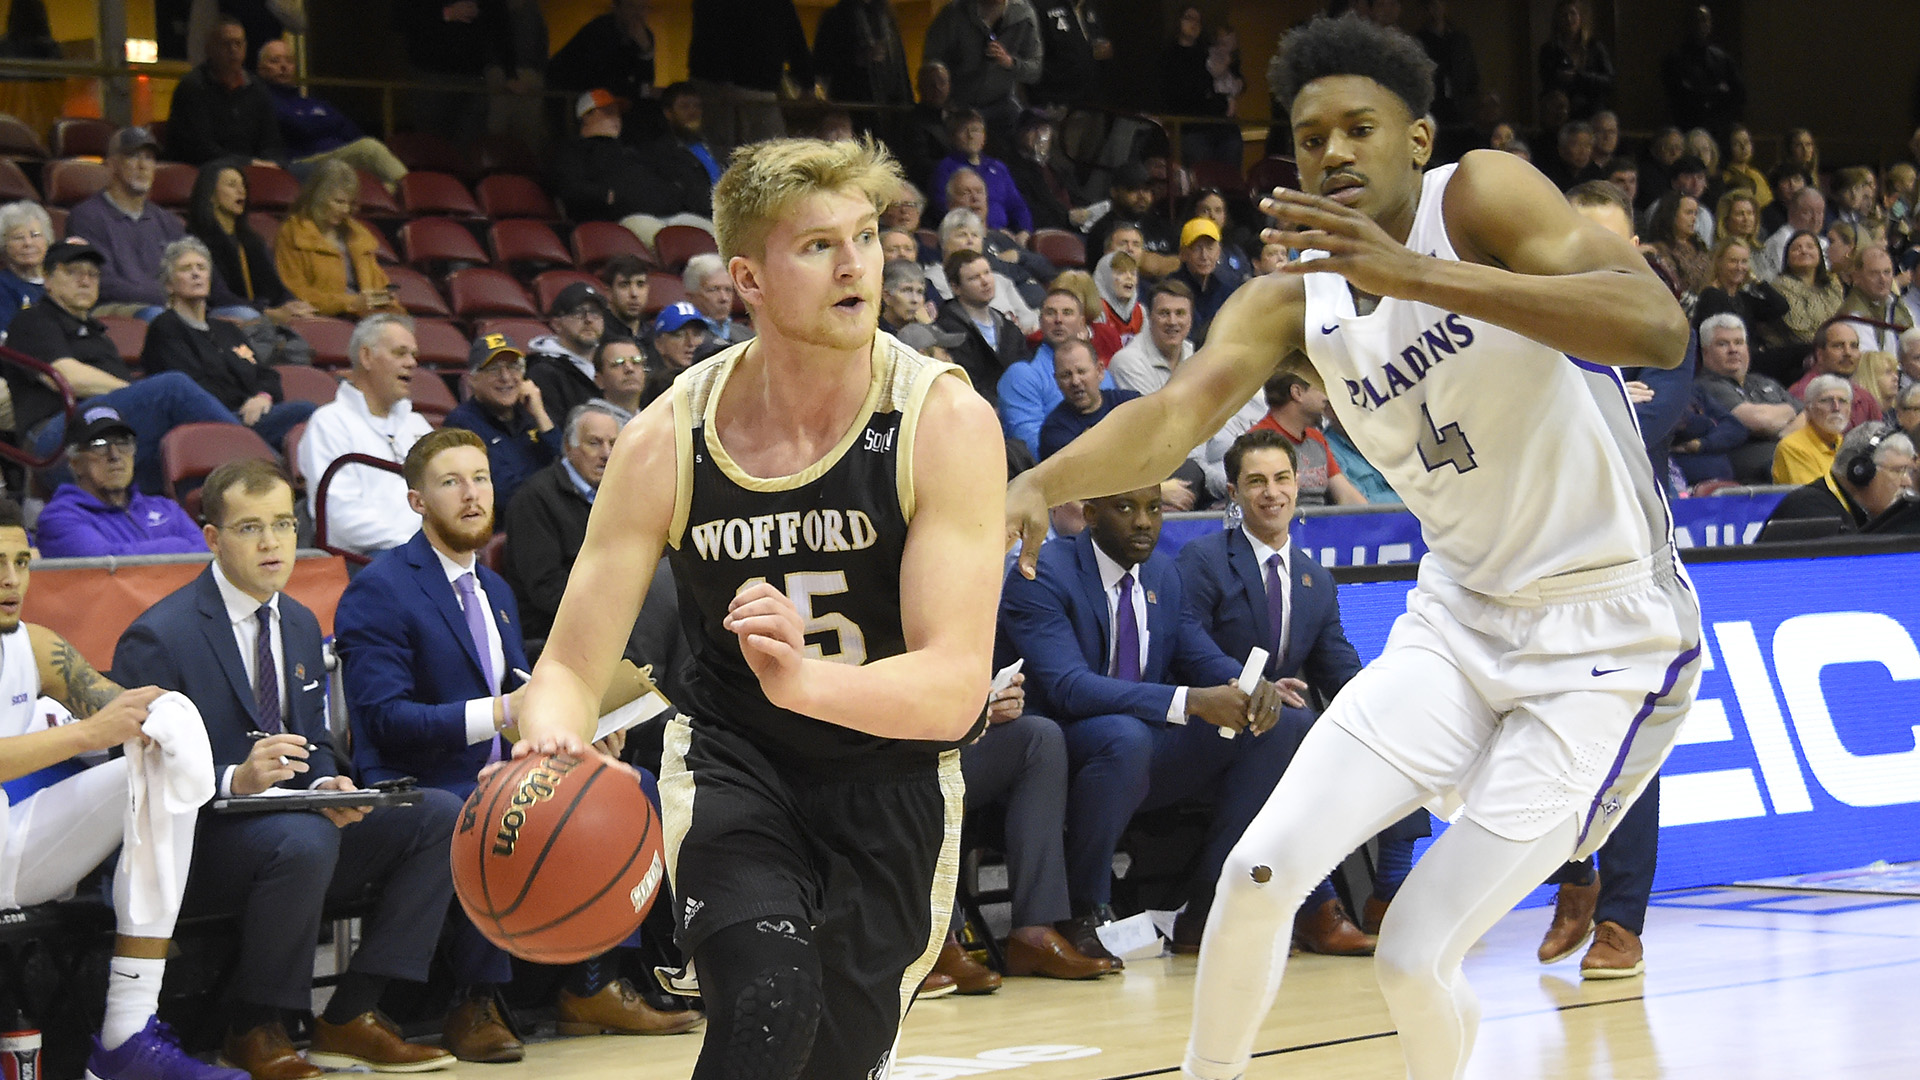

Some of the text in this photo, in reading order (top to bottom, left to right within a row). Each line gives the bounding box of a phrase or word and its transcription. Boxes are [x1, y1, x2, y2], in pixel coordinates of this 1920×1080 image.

[1341, 313, 1475, 412] PLADNS
[1416, 402, 1479, 475] 4
[691, 509, 878, 562] WOFFORD
[735, 570, 868, 667] 5
